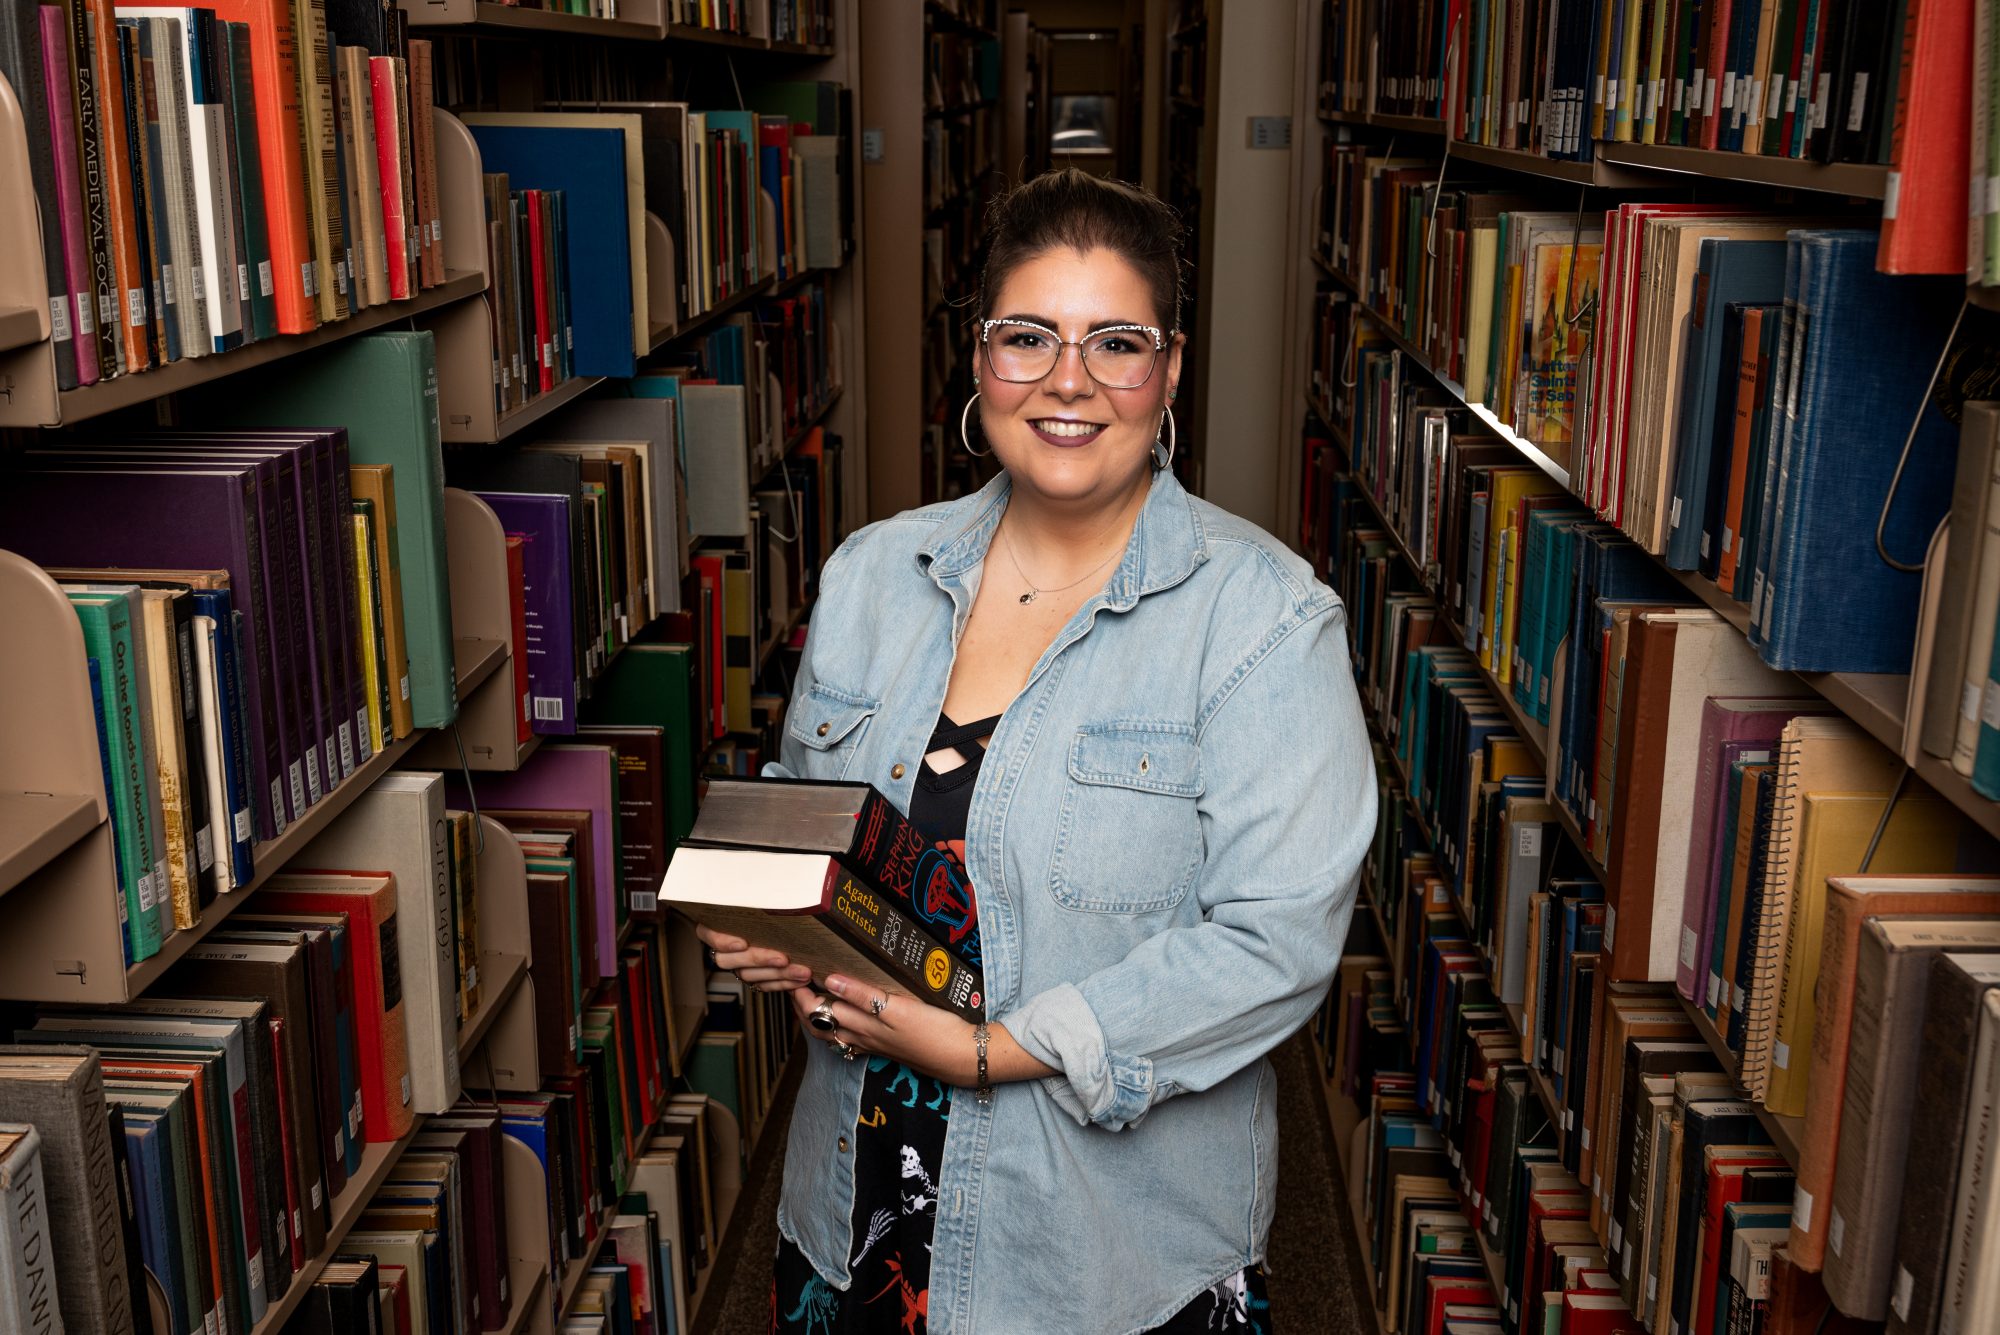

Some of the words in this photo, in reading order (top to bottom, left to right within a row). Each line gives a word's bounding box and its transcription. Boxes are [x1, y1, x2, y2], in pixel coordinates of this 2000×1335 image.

[79, 68, 95, 133] EARLY
[85, 138, 104, 247] MEDIEVAL
[94, 253, 113, 343] SOCY
[283, 496, 305, 656] RENAISSANCE
[116, 640, 126, 670] On
[119, 675, 131, 703] the
[124, 705, 139, 758] Roads
[130, 762, 138, 780] to
[132, 784, 150, 873] Modernity
[879, 816, 911, 887] STEPHEN
[434, 818, 447, 898] Circa
[891, 826, 925, 899] KING
[837, 896, 877, 937] Christie
[842, 879, 879, 916] Agatha
[436, 905, 451, 963] 1492
[880, 909, 897, 951] HERCULE
[887, 915, 903, 957] POIROT
[901, 936, 909, 949] THE
[903, 928, 918, 966] COMPLETE
[910, 939, 920, 963] SHORT
[1784, 887, 1800, 969] INVISIBLE
[914, 940, 926, 970] STORIES
[931, 957, 946, 985] 50
[951, 969, 968, 1004] CHARLES
[956, 973, 974, 1009] TODD
[82, 1069, 118, 1267] VANISHED
[1970, 1104, 1991, 1195] WESTERN
[1953, 1196, 1977, 1310] CIVILIZATION
